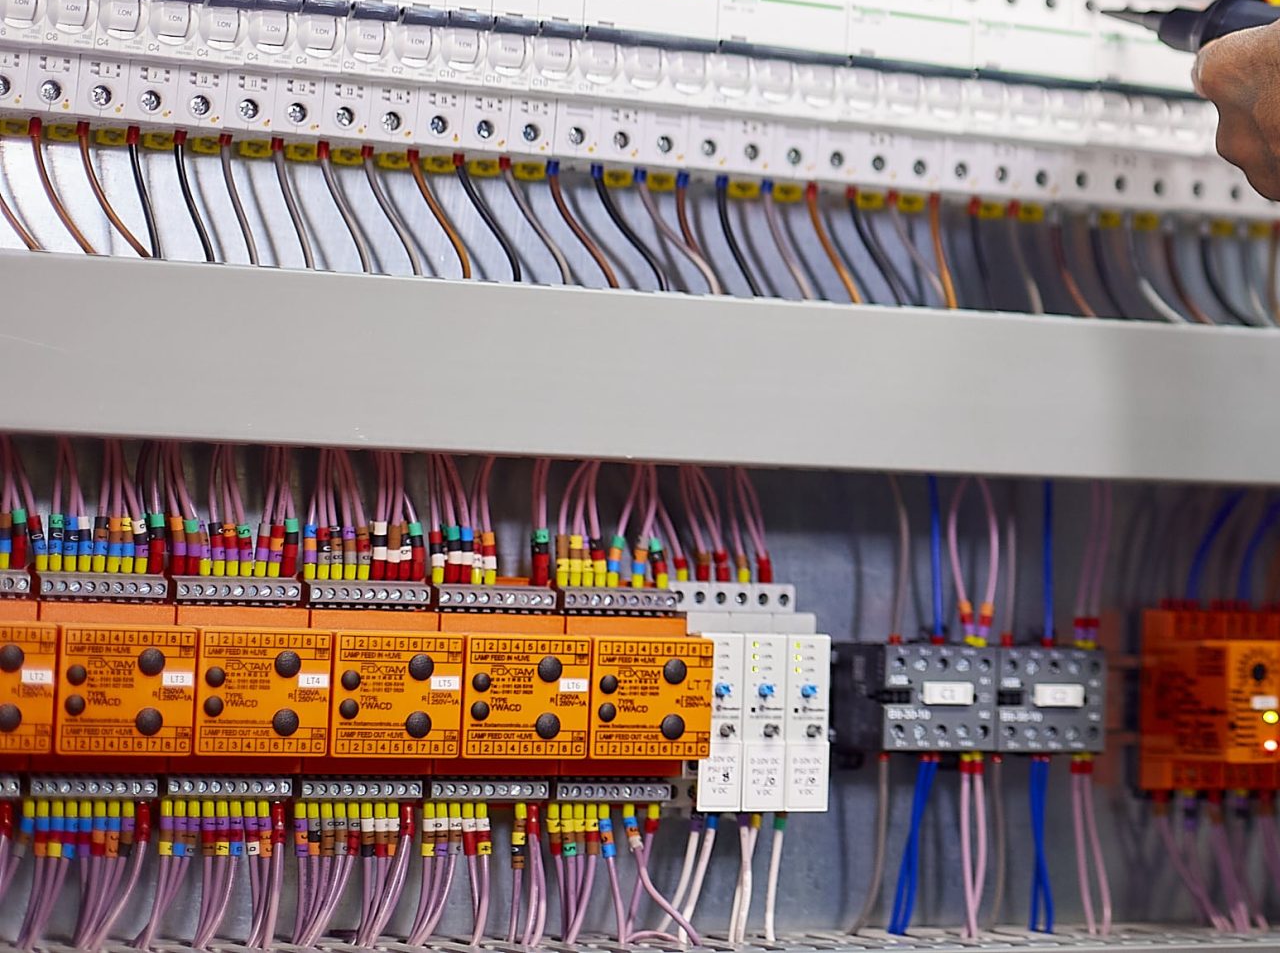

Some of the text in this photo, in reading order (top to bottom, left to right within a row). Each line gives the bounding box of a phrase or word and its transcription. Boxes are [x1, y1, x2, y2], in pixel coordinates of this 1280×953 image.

[46, 32, 58, 41] C6
[96, 38, 108, 46] C4
[148, 43, 160, 52] C4
[196, 48, 208, 57] C4
[246, 52, 258, 61] C4
[296, 56, 307, 65] C4
[343, 61, 355, 70] C2
[392, 66, 404, 74] C2
[440, 70, 456, 79] C10
[486, 75, 501, 84] C10
[223, 636, 228, 644] 2
[265, 637, 270, 645] 5
[88, 659, 136, 670] FOXTAM
[225, 661, 272, 672] FOXTAM
[361, 664, 406, 675] FOXTAM
[491, 666, 534, 677] FOXTAM
[618, 668, 660, 679] FOXTAM
[170, 675, 185, 683] LT3
[87, 698, 120, 706] YWACD
[360, 702, 392, 710] YWACD
[218, 741, 223, 749] 2
[301, 742, 306, 750] 8
[315, 742, 321, 750] C
[484, 744, 489, 752] 2
[498, 744, 502, 752] 3
